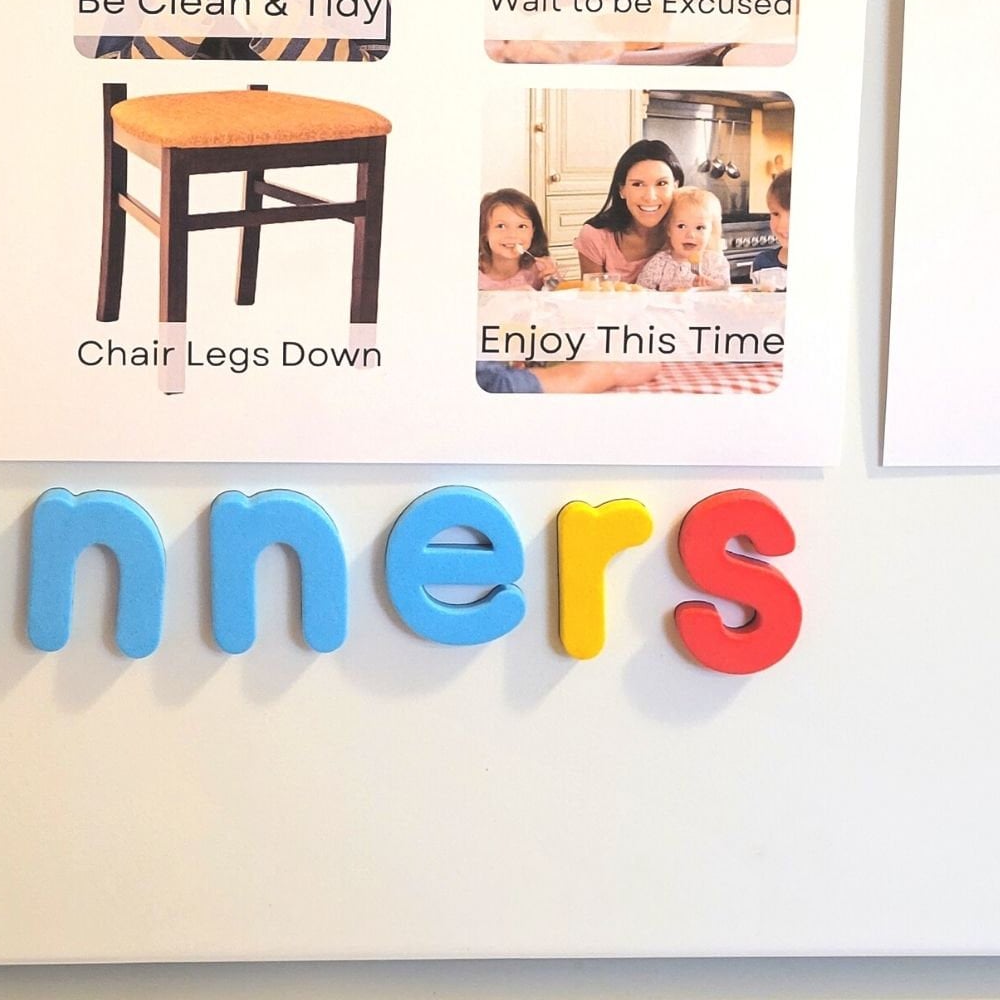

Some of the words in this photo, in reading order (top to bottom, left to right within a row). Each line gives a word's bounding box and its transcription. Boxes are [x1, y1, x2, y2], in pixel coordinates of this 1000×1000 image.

[78, 339, 175, 366] Chair
[188, 341, 269, 374] Legs
[282, 341, 381, 367] Down
[481, 324, 586, 362] Enjoy
[597, 324, 676, 354] This
[689, 325, 785, 355] Time
